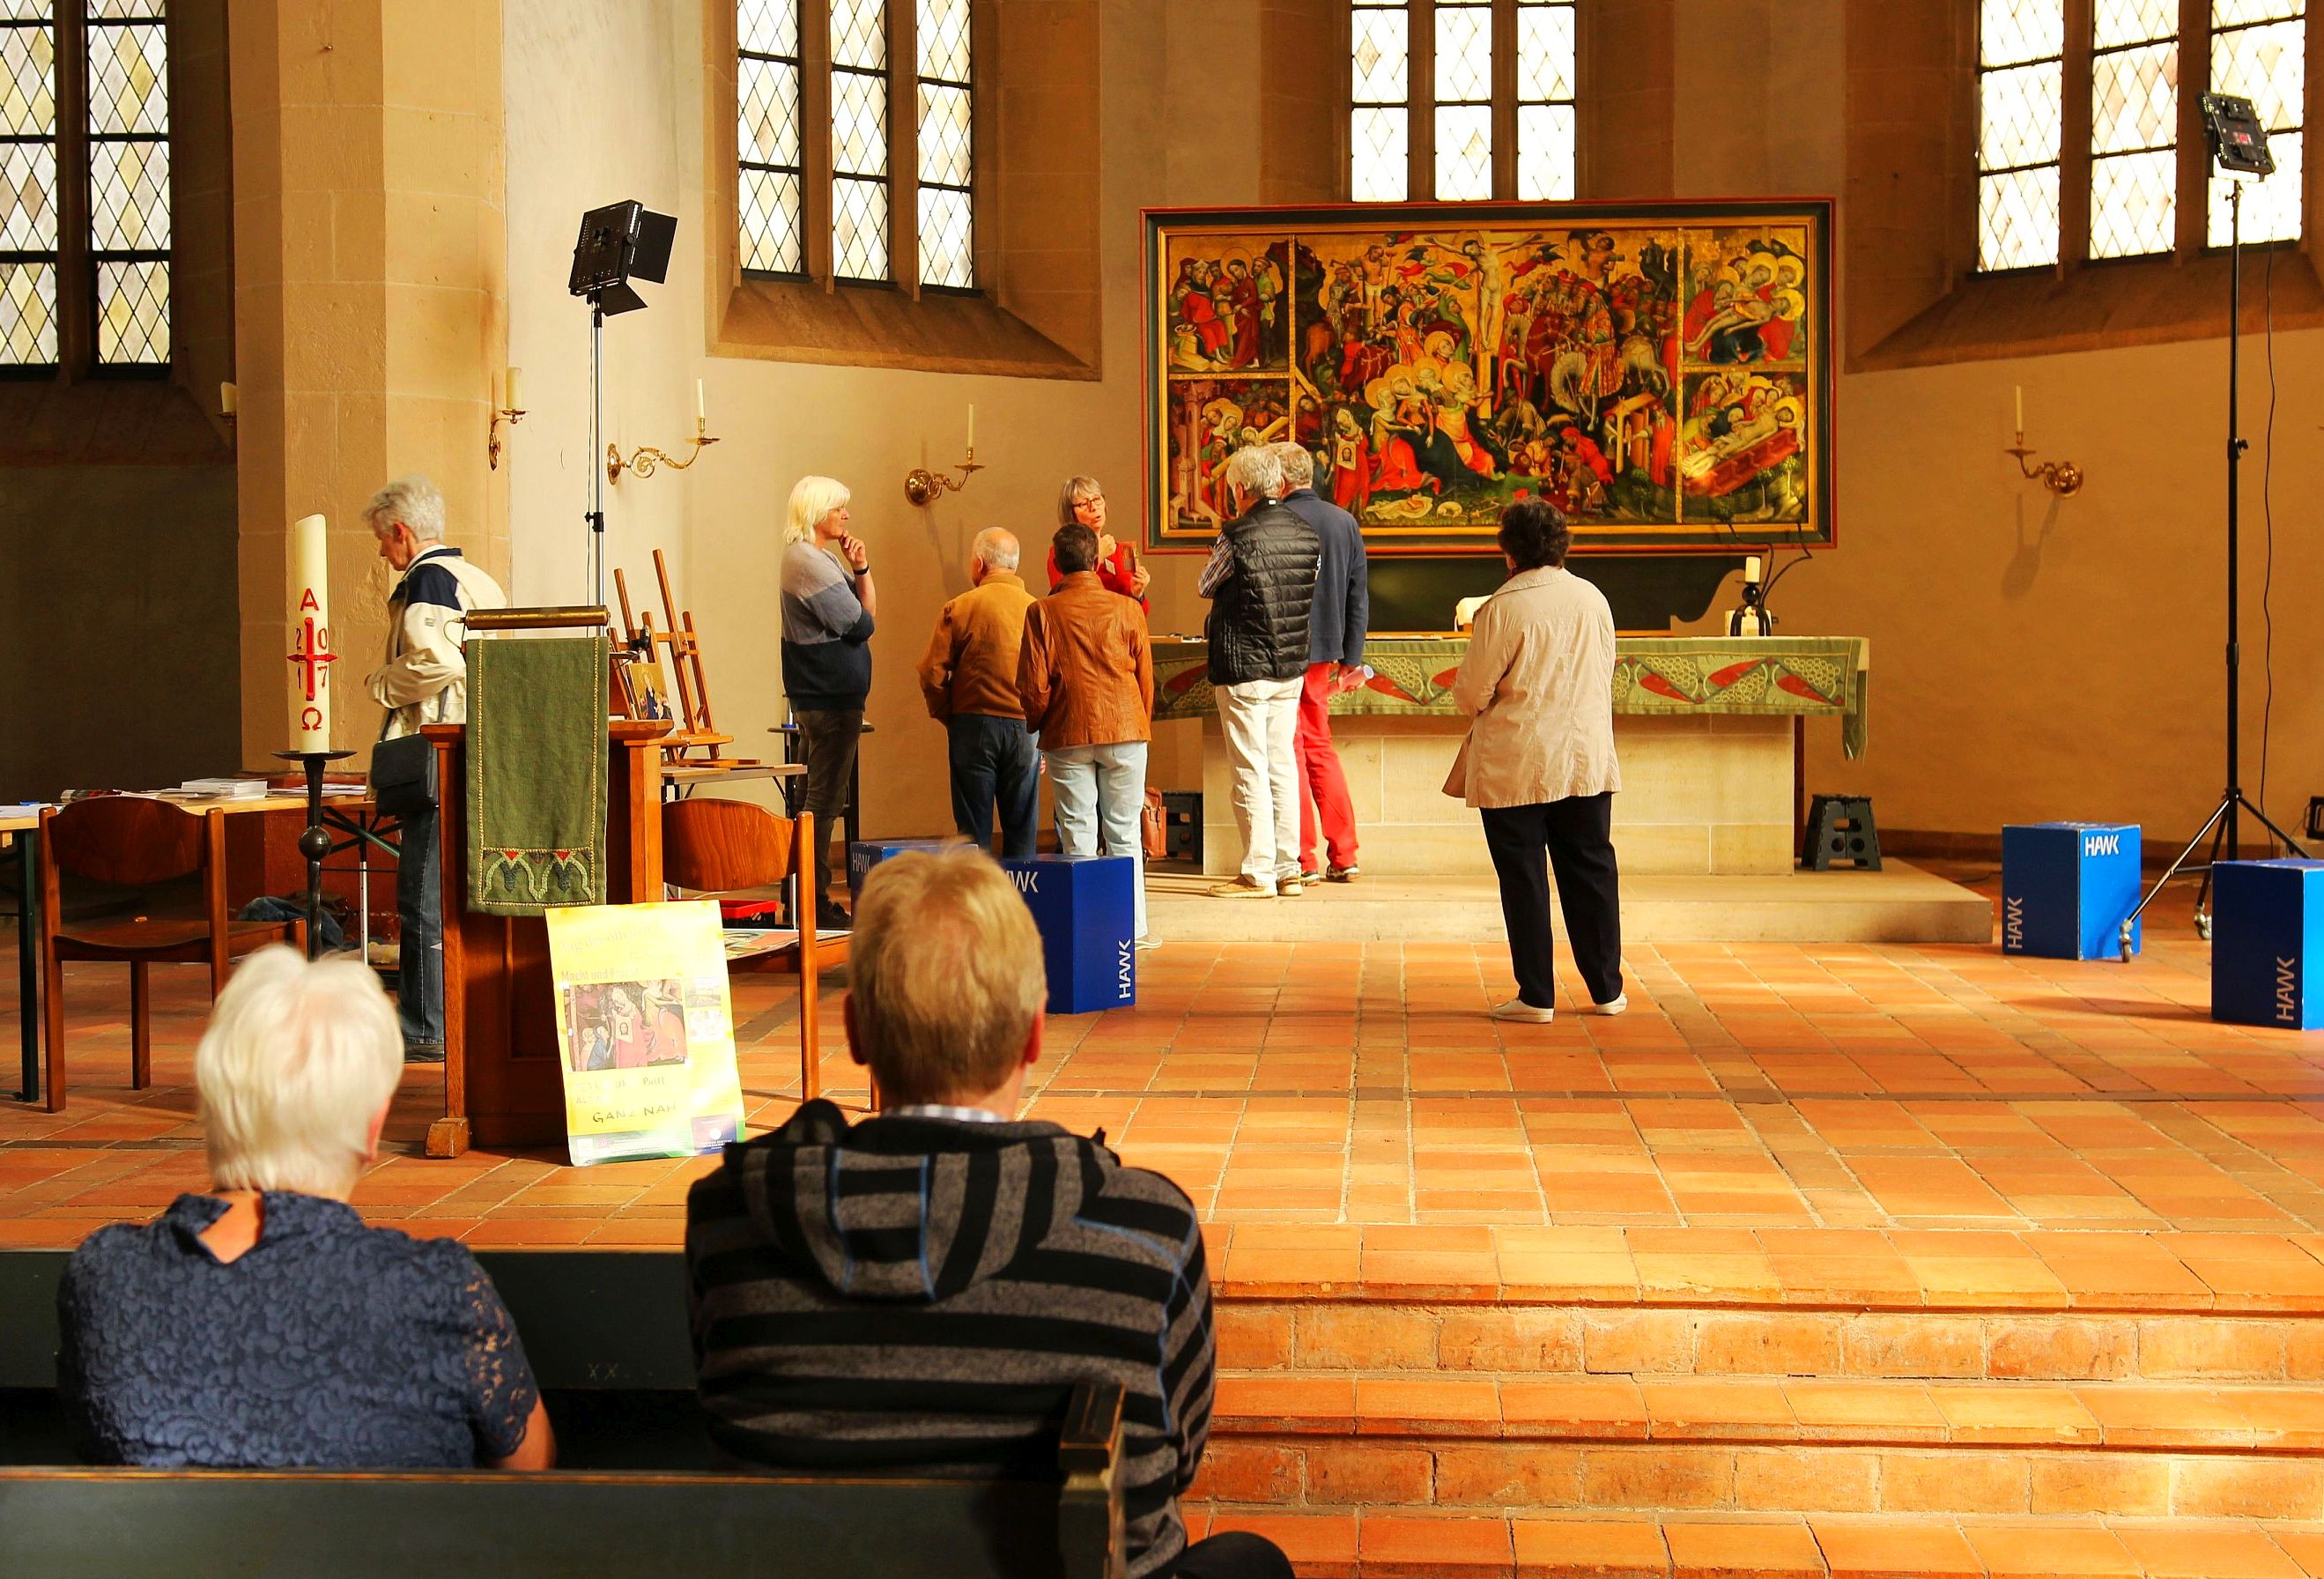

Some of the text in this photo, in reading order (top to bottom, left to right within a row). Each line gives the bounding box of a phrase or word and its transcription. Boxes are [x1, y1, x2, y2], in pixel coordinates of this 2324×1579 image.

[851, 851, 871, 875] HAWK
[2084, 834, 2120, 857] HAWK
[1004, 870, 1040, 894] WK
[2006, 896, 2024, 951] HAWK
[1118, 938, 1131, 1000] HAWK
[2276, 955, 2296, 1022] HAWK
